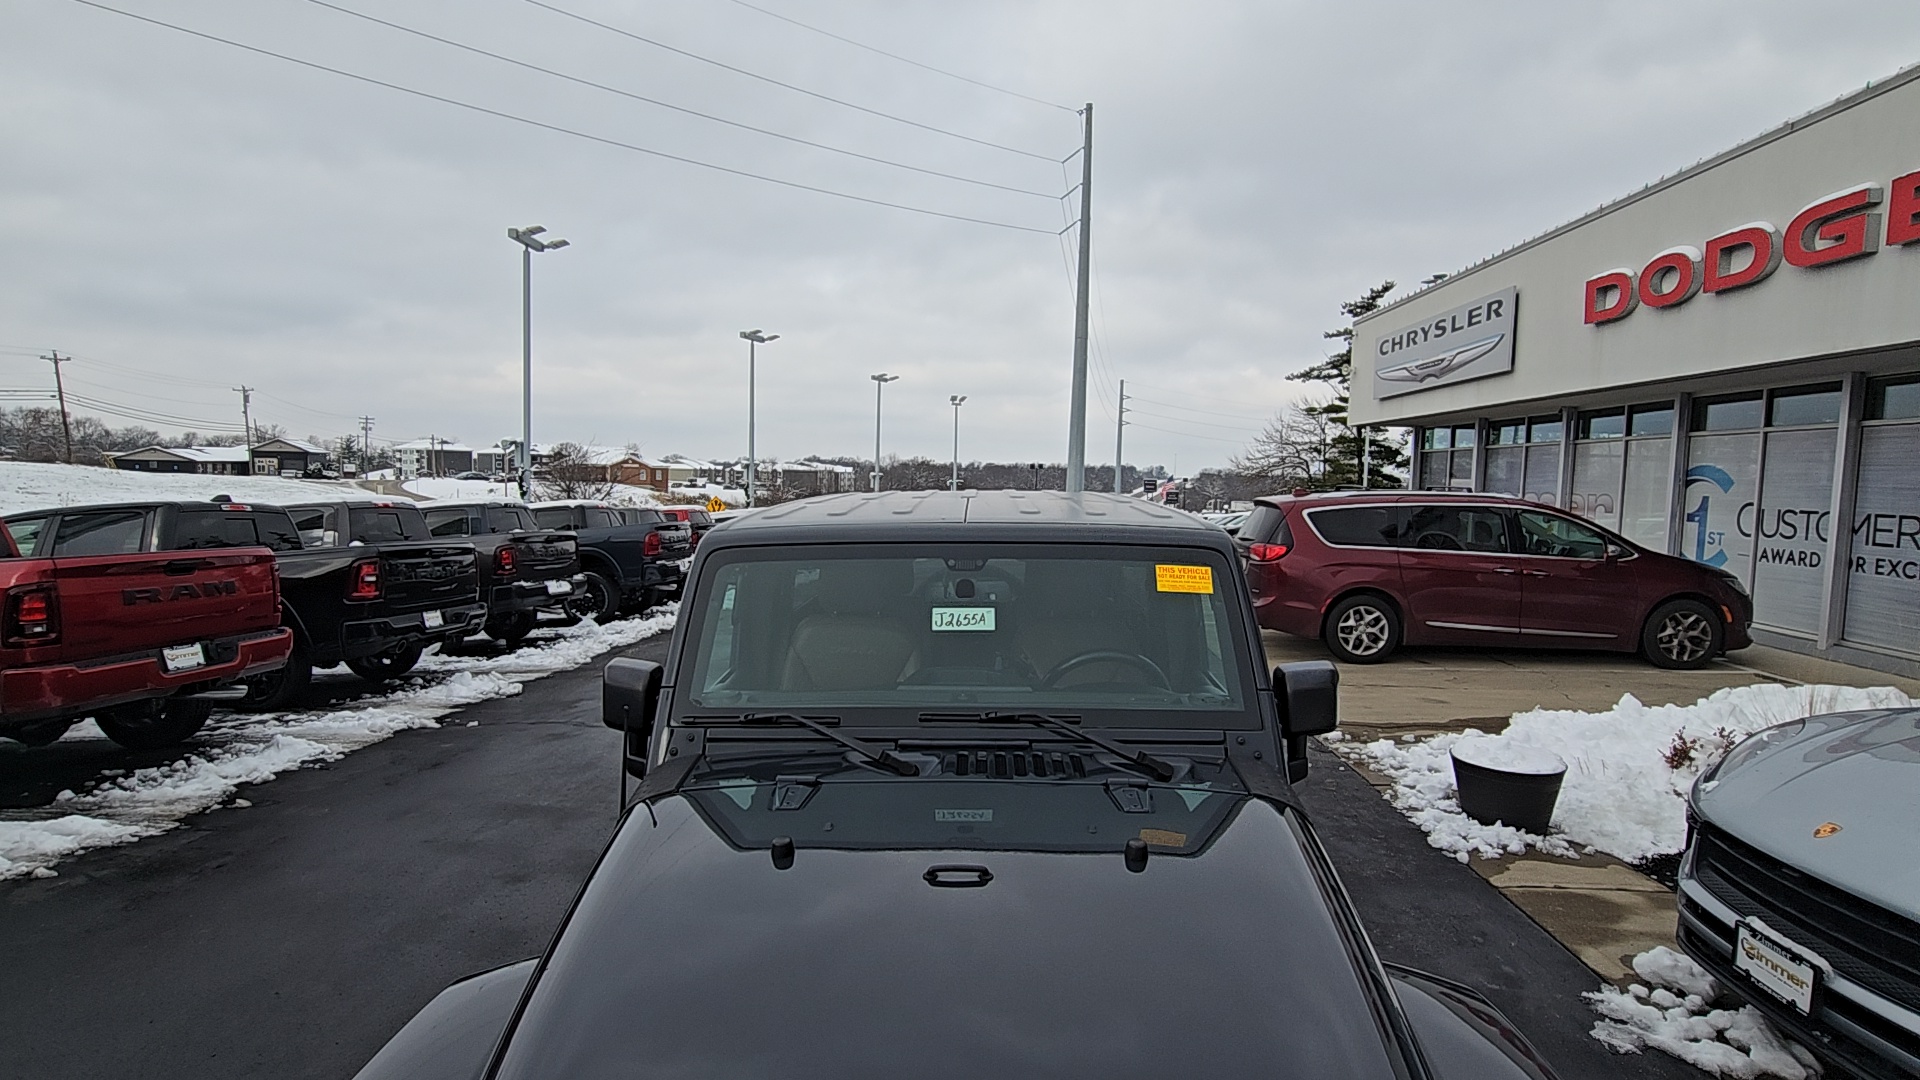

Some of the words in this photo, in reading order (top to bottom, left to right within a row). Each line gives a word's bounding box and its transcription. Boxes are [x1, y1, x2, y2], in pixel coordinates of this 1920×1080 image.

[1379, 299, 1504, 356] CHRYSLER
[1157, 566, 1176, 574] THIS
[1177, 567, 1210, 575] VEHICLE
[1759, 547, 1821, 568] AWARD
[1875, 558, 1920, 580] EXC
[122, 580, 238, 606] RAM
[934, 612, 986, 627] J2655A
[1755, 932, 1793, 961] Zimmer
[1741, 937, 1809, 989] Zimmer
